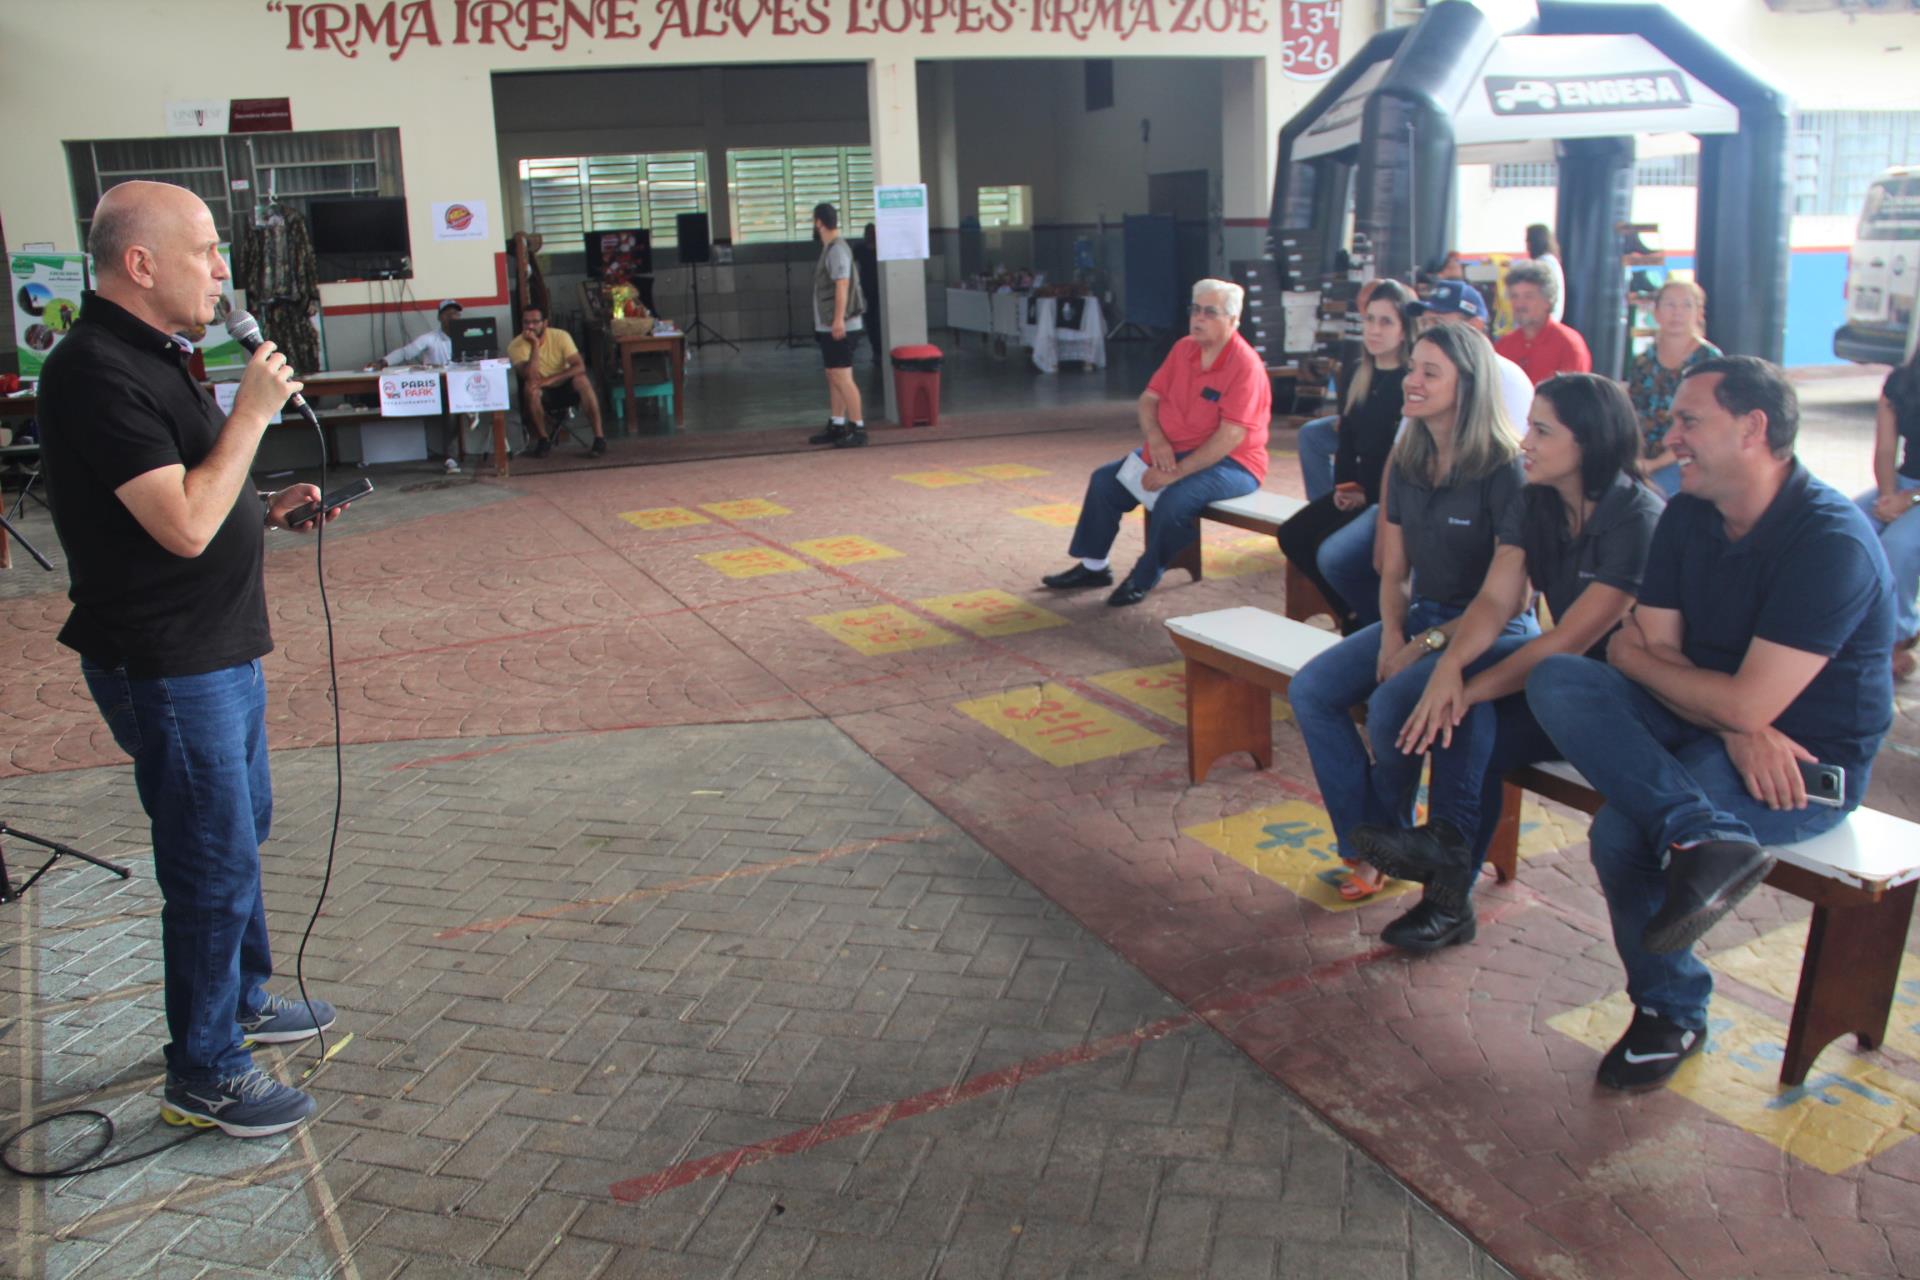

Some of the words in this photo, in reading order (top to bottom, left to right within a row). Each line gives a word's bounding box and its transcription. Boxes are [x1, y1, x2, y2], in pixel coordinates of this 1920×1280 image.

[453, 0, 641, 51] IRENE
[649, 0, 830, 50] ALVES
[1555, 76, 1683, 106] ENGESA
[401, 379, 436, 389] PARIS
[404, 388, 433, 397] PARK
